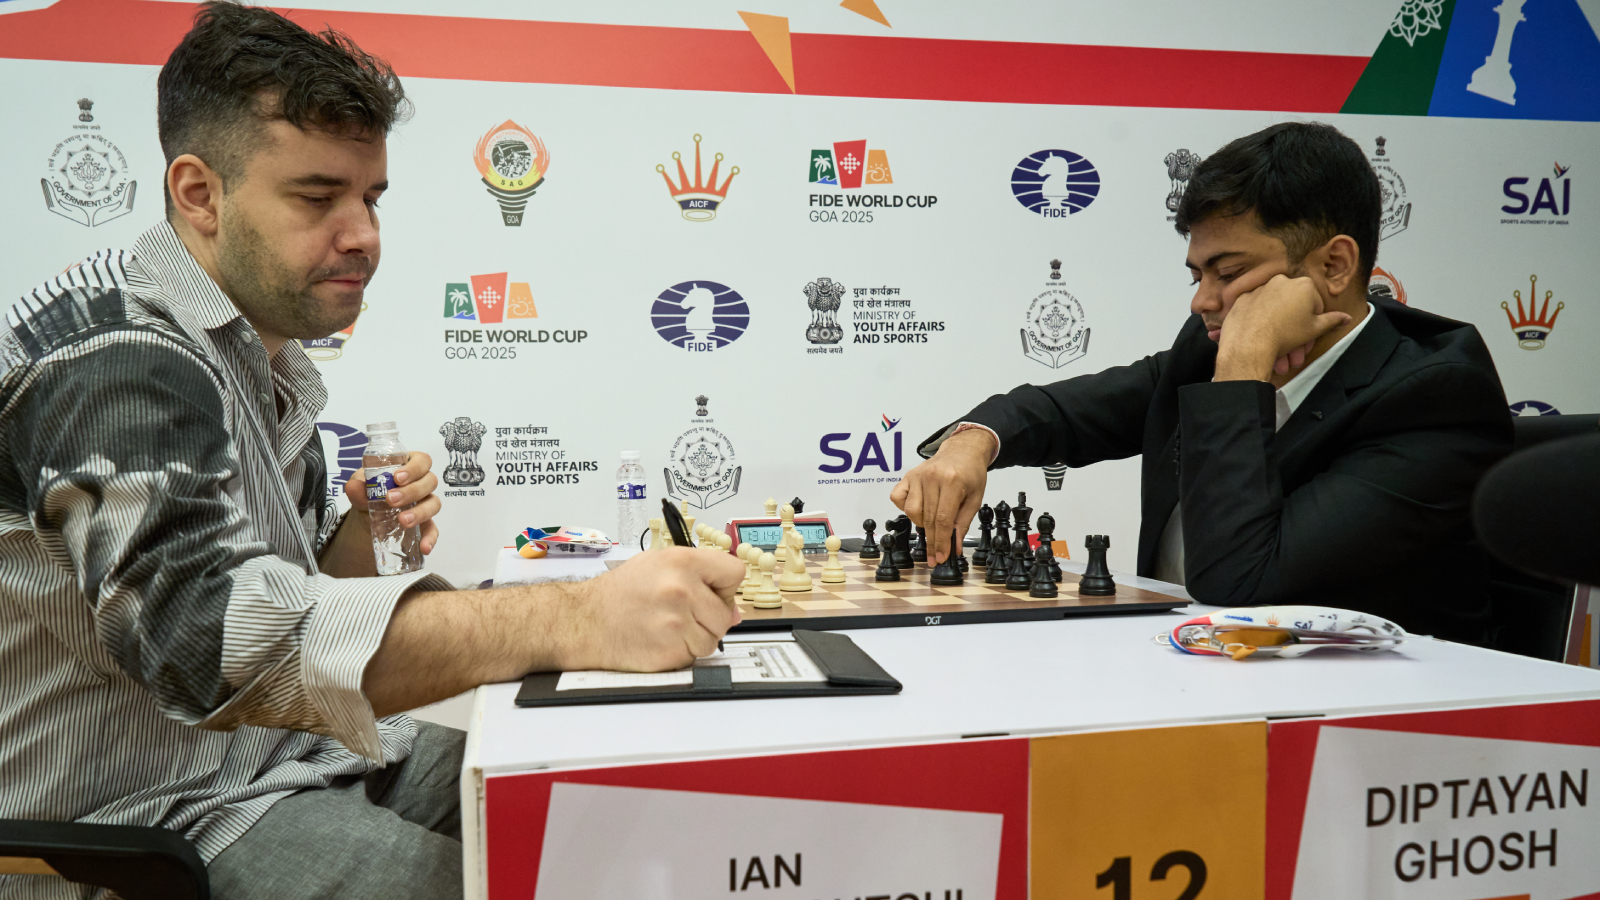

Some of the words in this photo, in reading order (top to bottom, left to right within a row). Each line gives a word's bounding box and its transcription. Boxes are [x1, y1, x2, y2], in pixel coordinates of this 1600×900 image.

[53, 181, 101, 207] GOVERNMENT
[103, 195, 113, 204] OF
[112, 182, 126, 197] GOA
[1501, 176, 1571, 216] SAI
[688, 200, 709, 208] AICF
[809, 193, 844, 208] FIDE
[845, 194, 903, 208] WORLD
[905, 195, 938, 209] CUP
[506, 214, 520, 224] GOA
[809, 210, 838, 223] GOA
[841, 210, 874, 223] 2025
[1043, 208, 1067, 218] FIDE
[852, 287, 868, 298] युवा
[869, 285, 901, 296] कार्यक्रम
[852, 298, 865, 309] एवं
[866, 297, 883, 308] खेल
[883, 298, 912, 308] मंत्रालय
[853, 310, 900, 320] MINISTRY
[902, 310, 917, 320] OF
[853, 321, 895, 332] YOUTH
[897, 321, 946, 332] AFFAIRS
[444, 329, 483, 344] FIDE
[485, 330, 550, 344] WORLD
[552, 330, 588, 344] CUP
[853, 333, 880, 344] AND
[883, 333, 928, 344] SPORTS
[1029, 330, 1064, 352] GOVERNMENT
[1065, 340, 1073, 349] OF
[1072, 330, 1083, 343] GOA
[1524, 331, 1540, 339] AICF
[311, 338, 333, 347] AICF
[687, 342, 714, 352] FIDE
[445, 346, 477, 360] GOA
[481, 346, 517, 360] 2025
[495, 427, 511, 437] युवा
[513, 424, 548, 435] कार्यक्रम
[495, 438, 508, 449] एवं
[510, 436, 528, 448] खेल
[530, 438, 560, 448] मंत्रालय
[495, 451, 548, 461] MINISTRY
[550, 450, 566, 460] OF
[818, 430, 903, 474] SAI
[496, 462, 542, 473] YOUTH
[545, 461, 599, 472] AFFAIRS
[496, 474, 526, 486] AND
[529, 473, 580, 485] SPORTS
[674, 469, 712, 492] GOVERNMENT
[713, 480, 722, 488] OF
[722, 467, 733, 482] GOA
[1049, 480, 1060, 489] GOA
[925, 615, 942, 626] DGT
[1366, 768, 1589, 828] DIPTAYAN
[1394, 828, 1558, 883] GHOSH
[729, 853, 802, 892] IAN
[1095, 849, 1209, 900] 12
